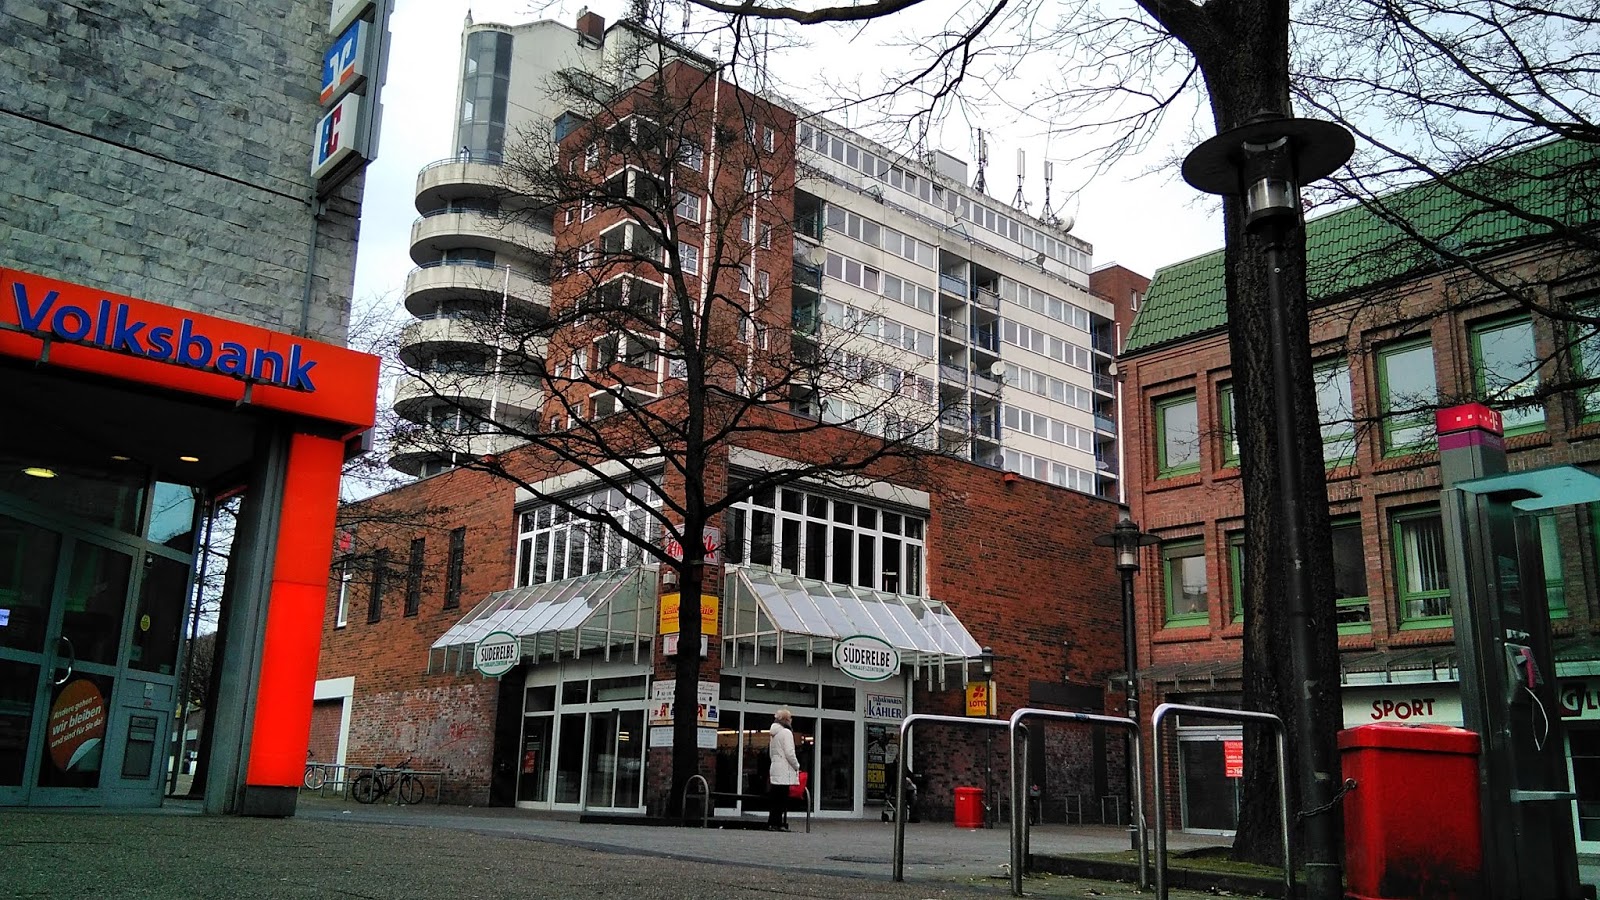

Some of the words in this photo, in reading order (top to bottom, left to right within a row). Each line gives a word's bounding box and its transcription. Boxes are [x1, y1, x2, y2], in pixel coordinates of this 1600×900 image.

[12, 282, 317, 391] Volksbank
[843, 643, 890, 667] SÜDERELBE
[969, 700, 988, 708] LOTTO
[1370, 698, 1436, 721] SPORT
[52, 719, 69, 736] wir
[69, 705, 102, 728] bleiben
